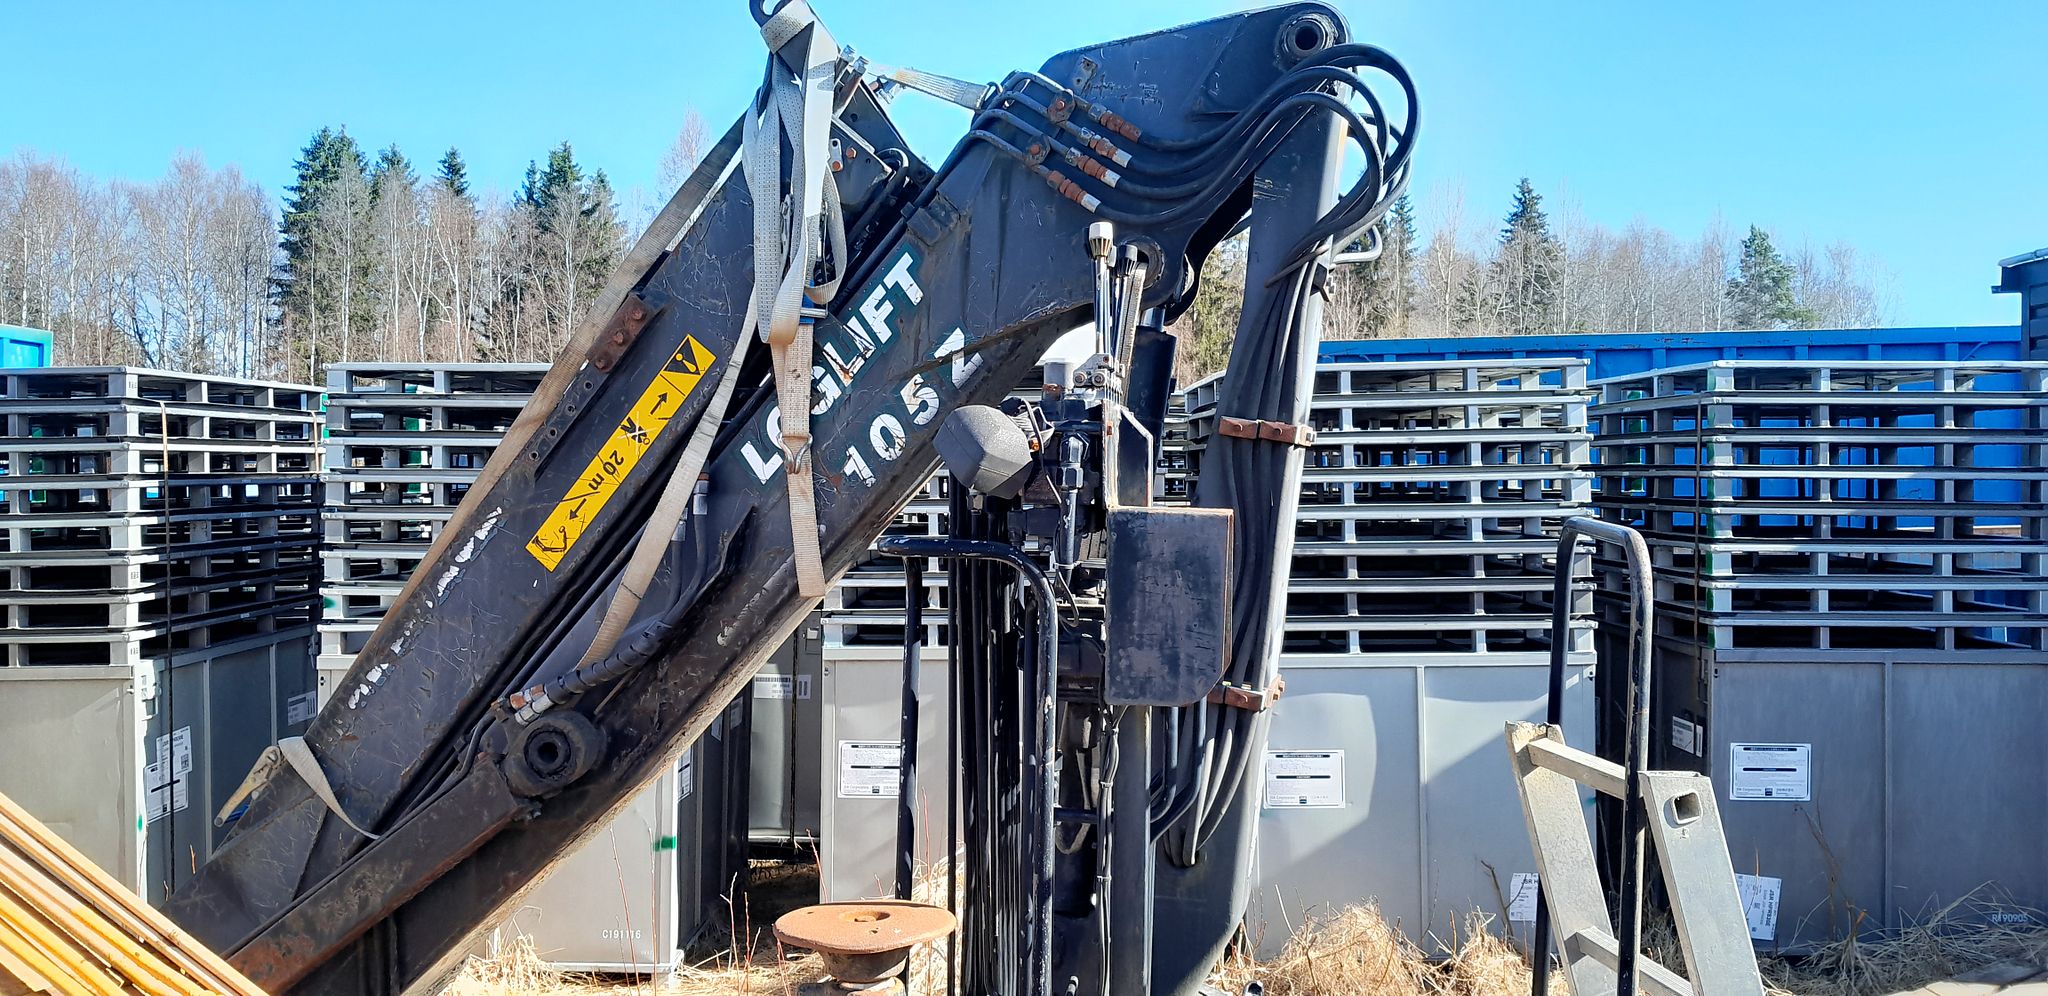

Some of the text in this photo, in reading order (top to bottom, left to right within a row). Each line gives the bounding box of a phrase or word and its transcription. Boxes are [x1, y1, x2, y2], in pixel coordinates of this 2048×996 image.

[588, 450, 624, 490] 20 m
[602, 929, 641, 939] C191116
